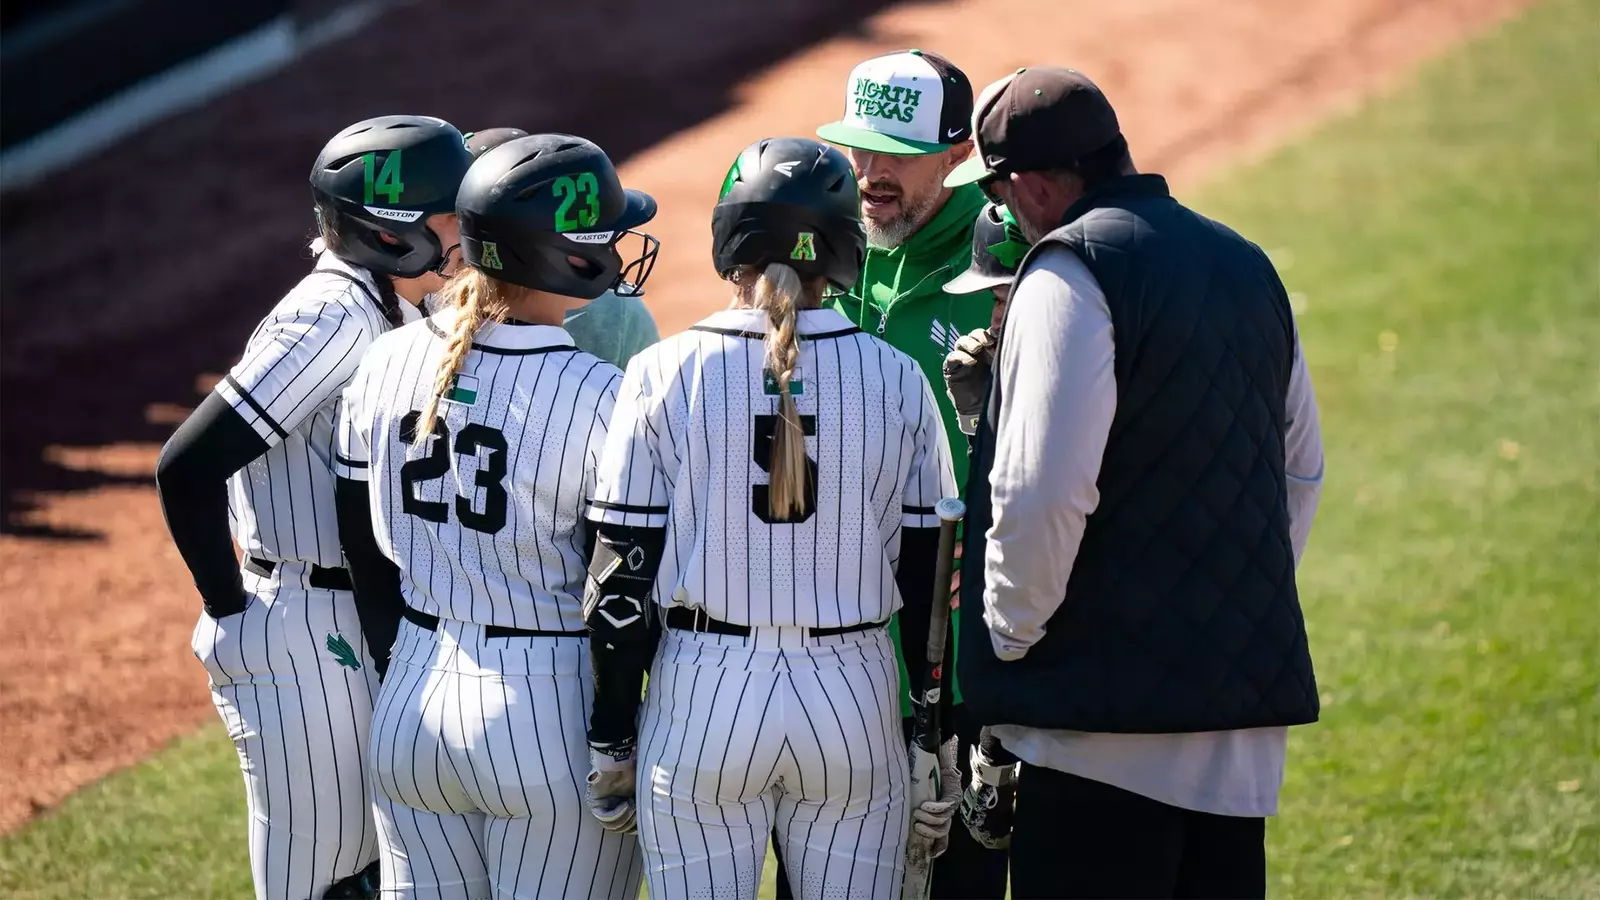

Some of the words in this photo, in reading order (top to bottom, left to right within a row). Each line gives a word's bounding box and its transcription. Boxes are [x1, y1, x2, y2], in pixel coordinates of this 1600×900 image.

[854, 78, 922, 107] NORTH
[855, 98, 915, 123] TEXAS
[361, 149, 404, 205] 14
[376, 209, 416, 218] EASTON
[552, 172, 600, 233] 23
[575, 233, 608, 241] EASTON
[399, 409, 508, 535] 23
[752, 414, 818, 524] 5
